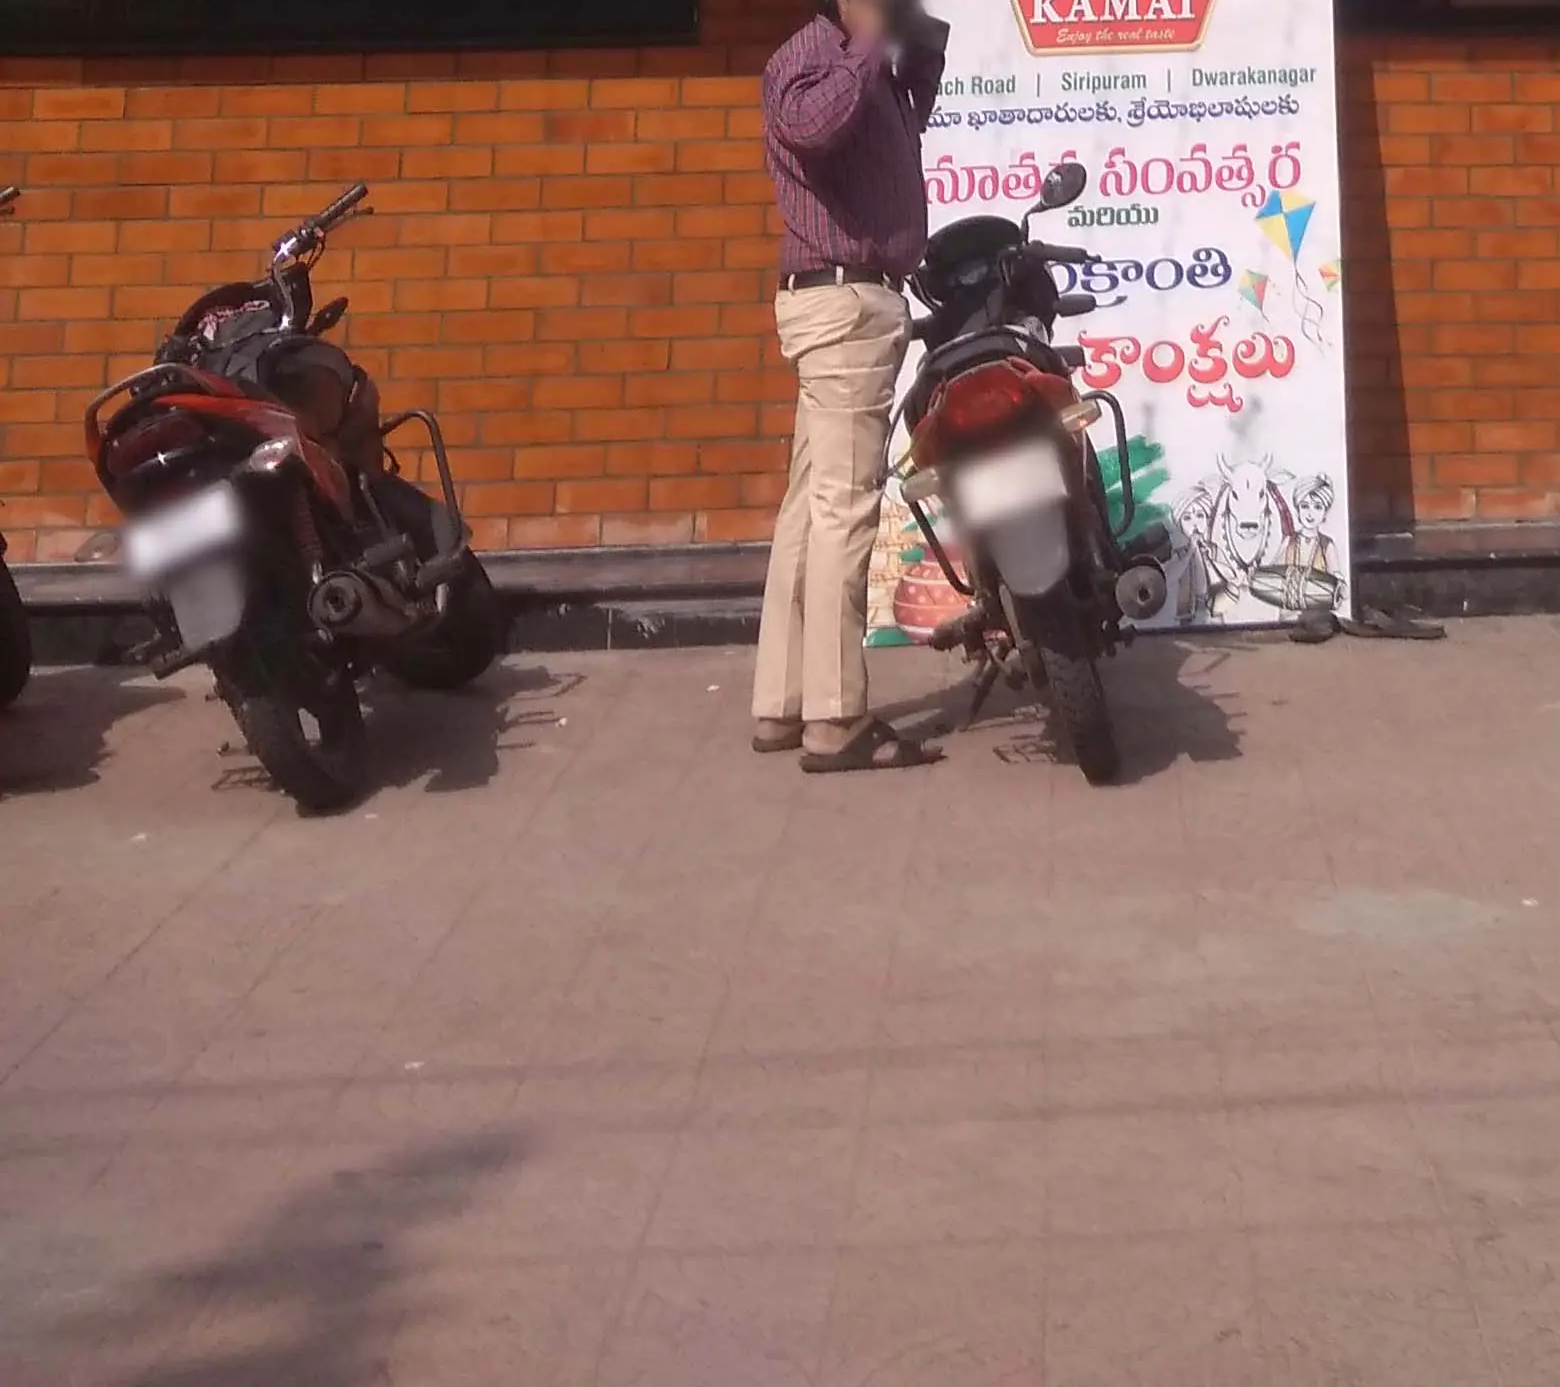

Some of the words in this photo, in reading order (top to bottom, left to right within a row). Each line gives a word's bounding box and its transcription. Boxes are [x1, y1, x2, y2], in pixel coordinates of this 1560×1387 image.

[971, 74, 1016, 95] Road
[1061, 71, 1147, 94] Siripuram
[1192, 66, 1317, 87] Dwarakanagar
[1099, 141, 1301, 208] సంవత్సర
[1067, 203, 1159, 227] మరియు
